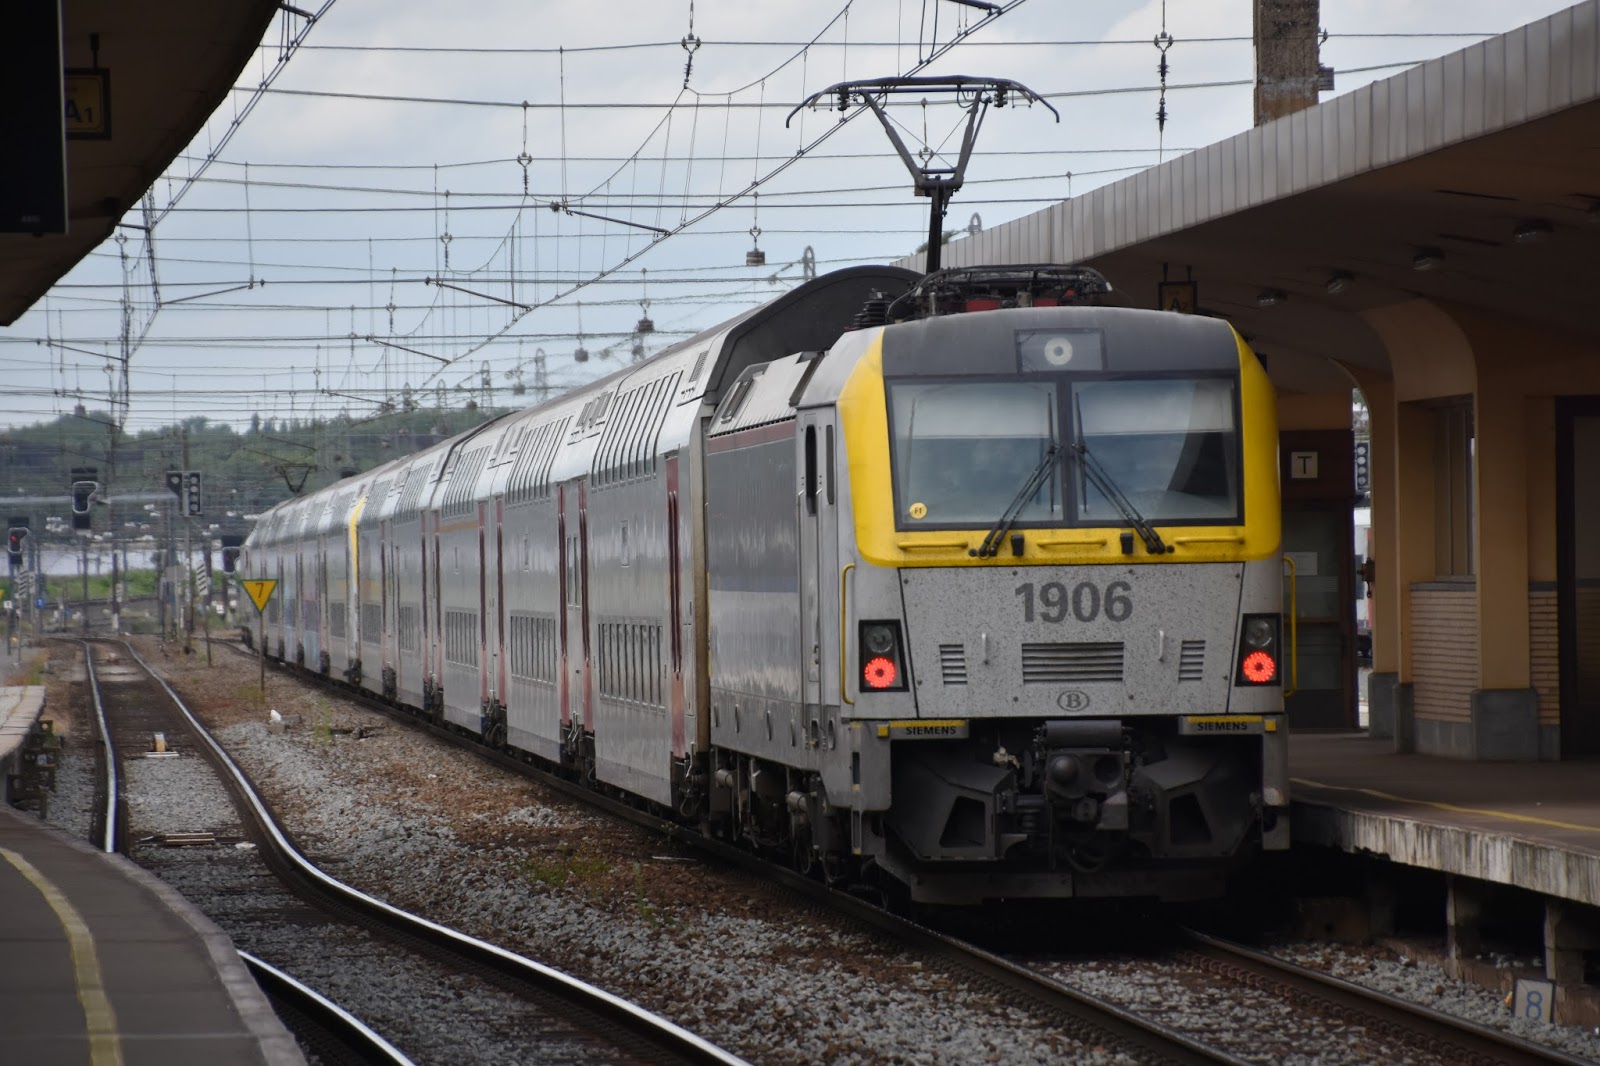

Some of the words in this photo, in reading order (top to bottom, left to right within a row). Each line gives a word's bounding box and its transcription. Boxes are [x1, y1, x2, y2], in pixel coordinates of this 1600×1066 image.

[1297, 455, 1312, 475] T
[255, 582, 264, 599] 7
[1015, 580, 1133, 623] 1906
[906, 726, 957, 735] SIEMENS
[1197, 721, 1248, 731] SIEMENS
[1525, 990, 1543, 1021] 8
